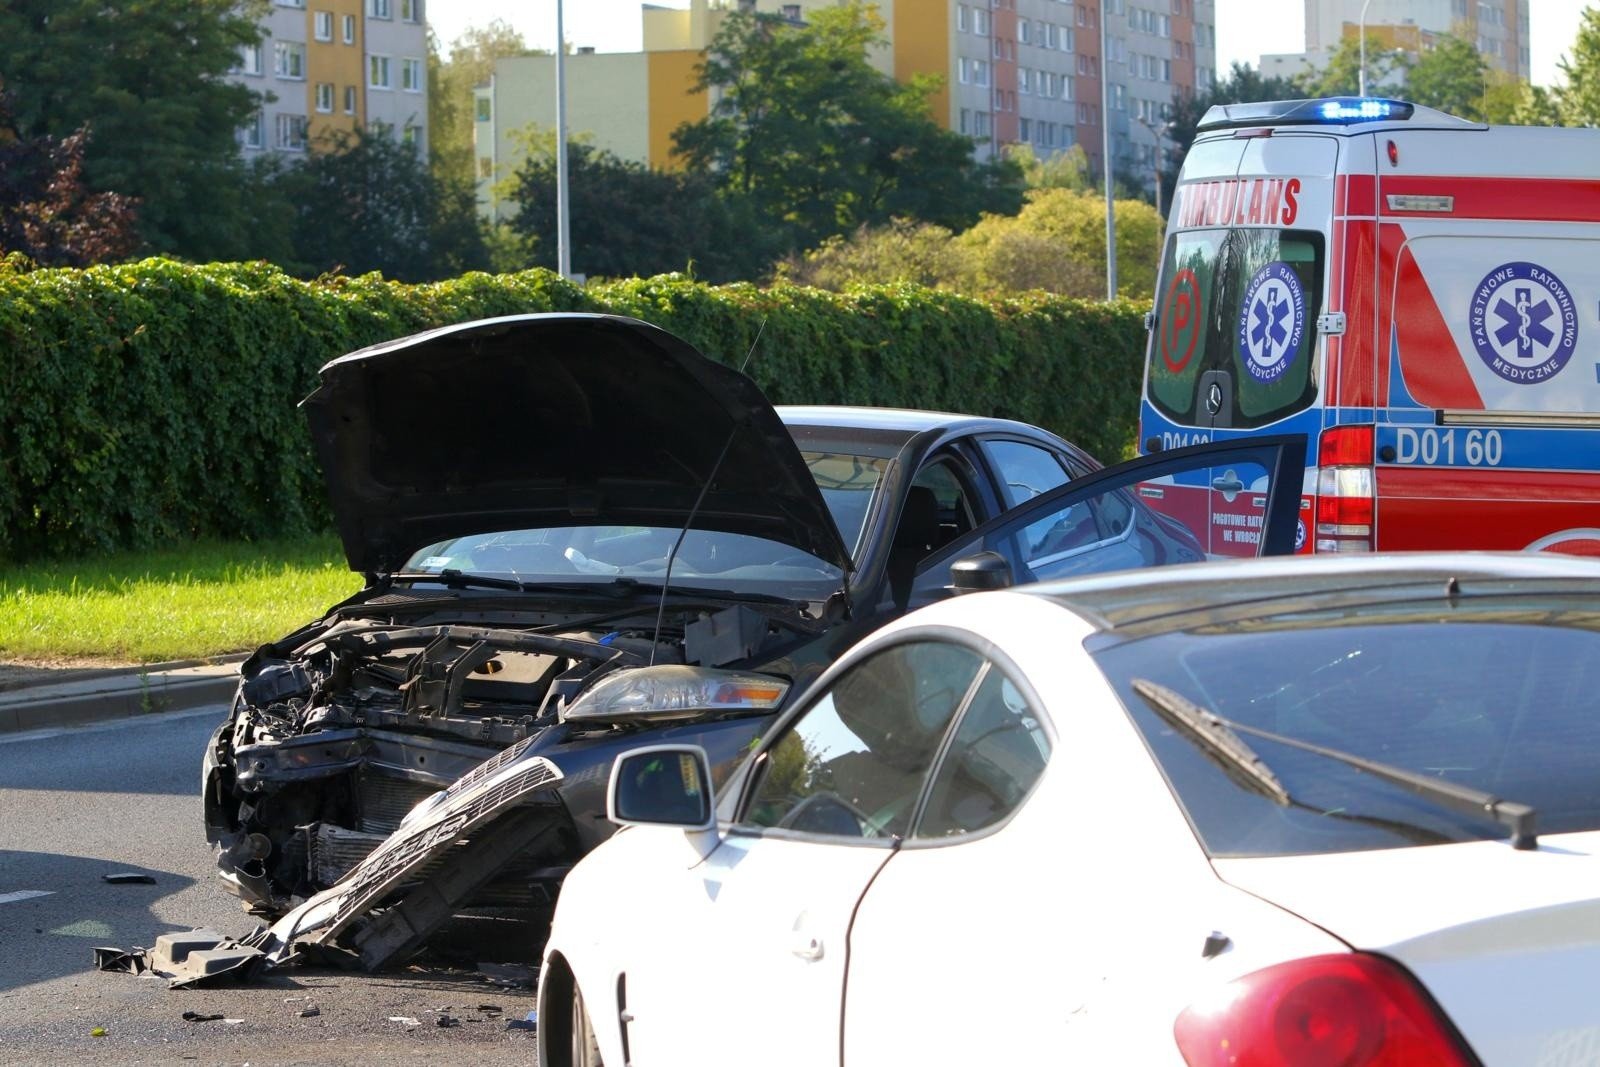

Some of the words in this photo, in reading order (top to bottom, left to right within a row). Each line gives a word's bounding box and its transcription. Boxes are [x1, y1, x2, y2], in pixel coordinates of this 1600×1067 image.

[1180, 178, 1301, 228] AMBULANS
[1279, 267, 1303, 347] RATOWNICTWO
[1472, 267, 1515, 346] PAŃSTWOWE
[1530, 267, 1575, 348] RATOWNICTWO
[1246, 357, 1287, 379] MEDYCZNE
[1492, 357, 1559, 380] MEDYCZNE
[1465, 429, 1503, 466] 60
[1223, 529, 1233, 542] WE
